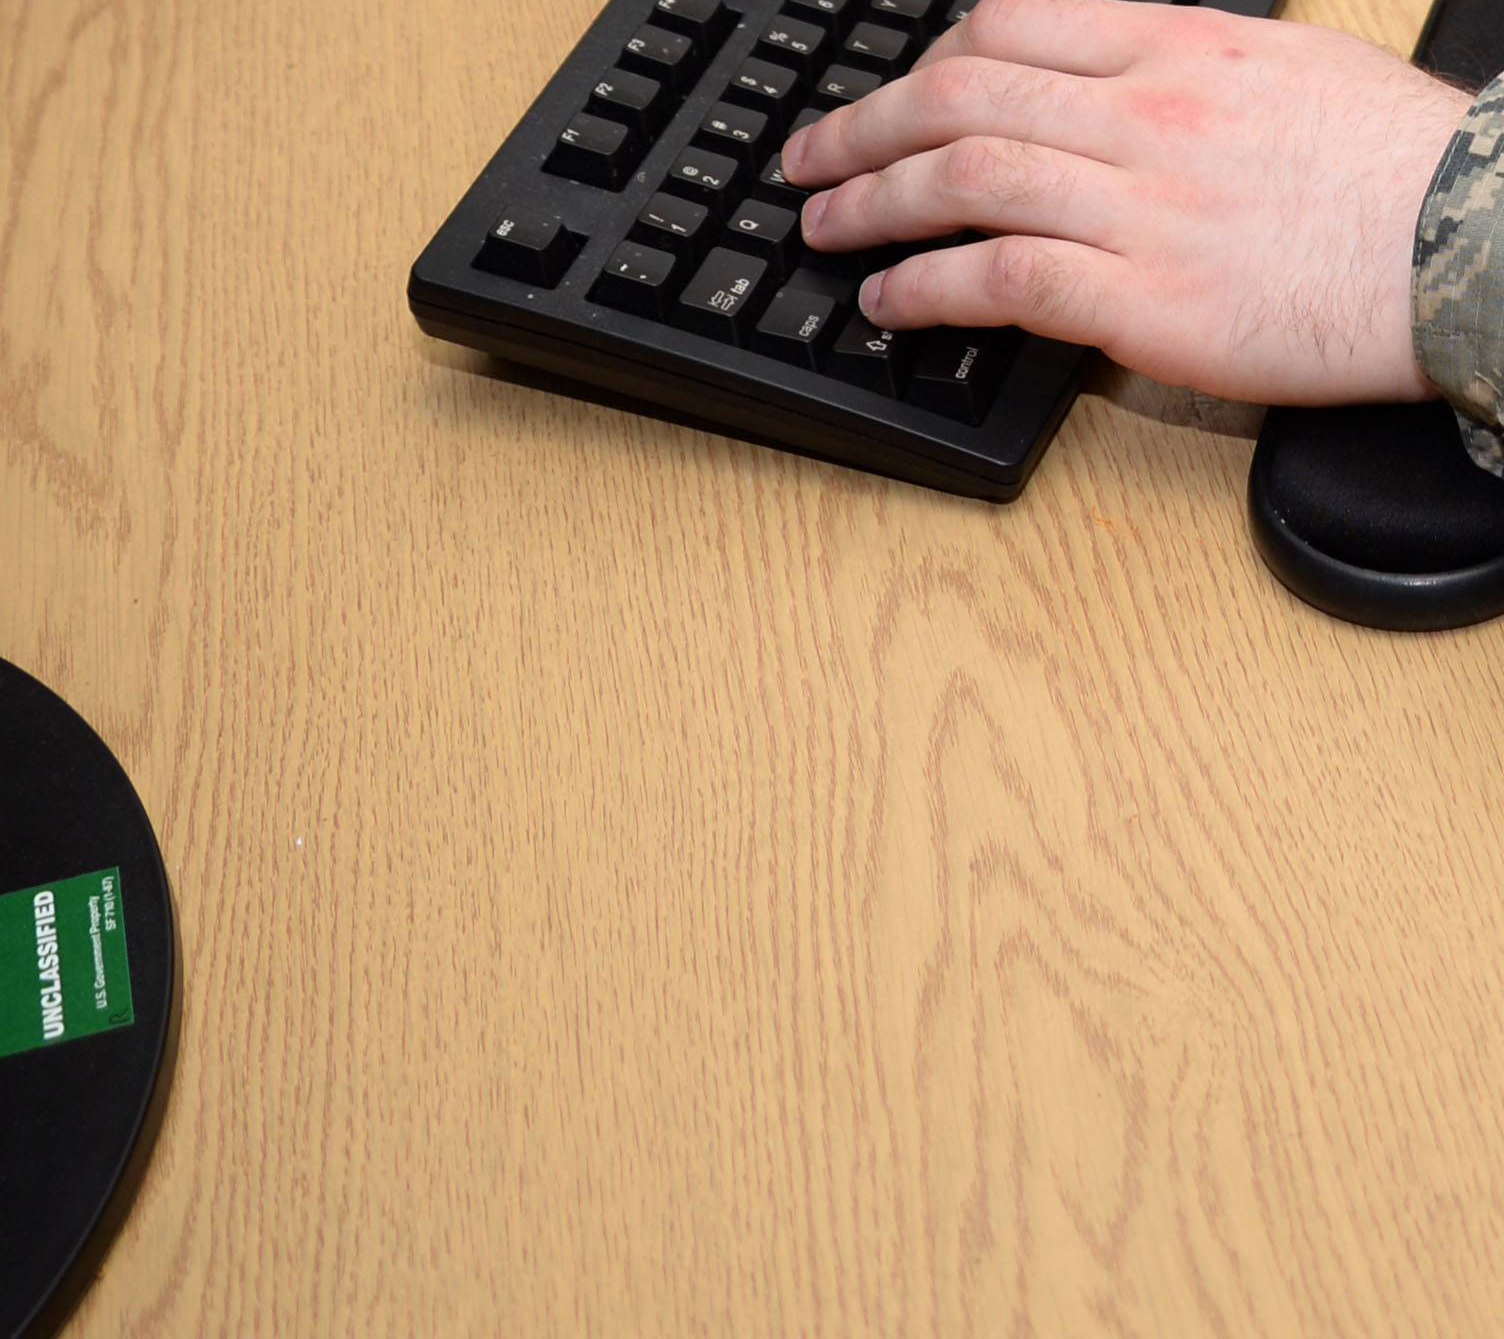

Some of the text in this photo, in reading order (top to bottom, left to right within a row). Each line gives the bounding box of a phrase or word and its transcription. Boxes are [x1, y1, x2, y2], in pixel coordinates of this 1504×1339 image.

[628, 38, 645, 51] F3
[595, 82, 613, 96] F2
[562, 128, 580, 142] F1
[496, 219, 515, 237] esc
[739, 219, 758, 230] Q
[731, 278, 750, 295] tab
[798, 314, 820, 337] caps
[955, 346, 979, 380] control
[104, 901, 115, 919] 710
[105, 920, 116, 931] SF
[88, 895, 108, 1009] U.S. Government Property
[34, 890, 65, 1040] UNCLASSIFIED
